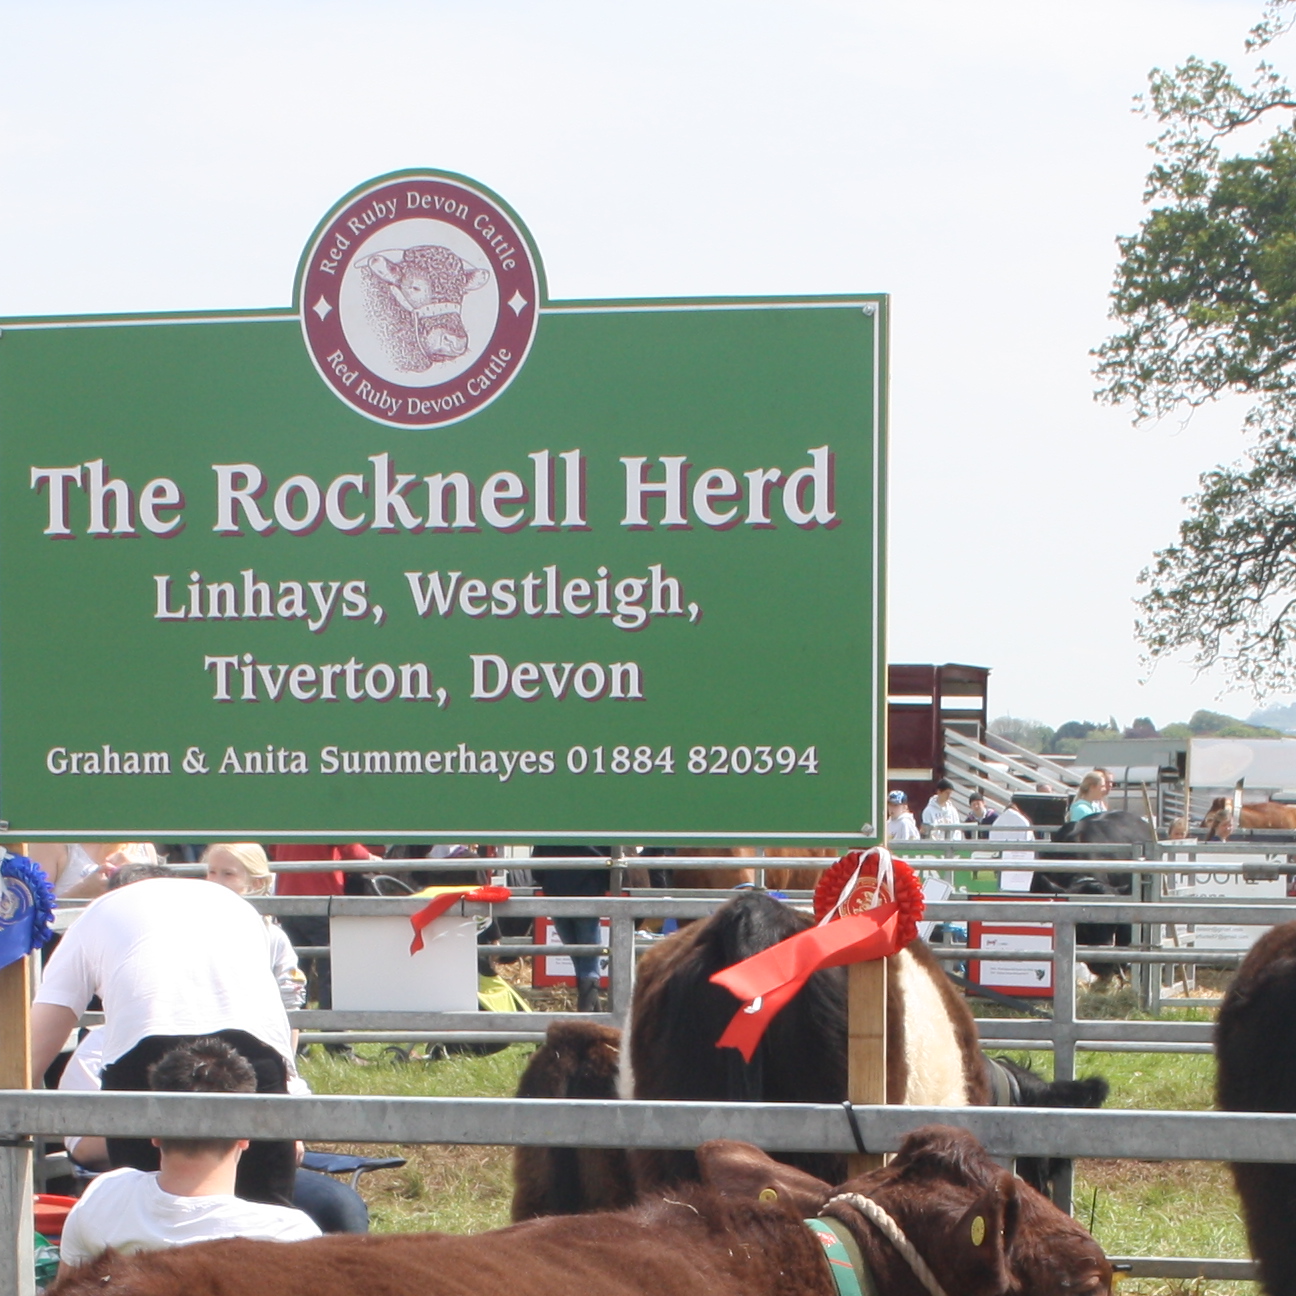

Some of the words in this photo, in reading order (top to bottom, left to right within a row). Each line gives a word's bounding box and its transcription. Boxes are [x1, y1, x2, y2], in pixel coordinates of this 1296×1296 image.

[319, 233, 351, 275] Red
[347, 197, 398, 236] Ruby
[406, 191, 470, 220] Devon
[473, 214, 517, 272] Cattle
[326, 349, 359, 387] Red
[355, 379, 403, 417] Ruby
[407, 391, 466, 416] Devon
[466, 347, 512, 397] Cattle
[30, 458, 183, 536] The
[211, 449, 589, 535] Rocknell
[619, 445, 839, 529] Herd
[153, 568, 385, 632] Linhays,
[403, 563, 701, 630] Westleigh,
[204, 653, 449, 708] Tiverton,
[469, 654, 644, 701] Devon
[46, 744, 172, 775] Graham
[182, 746, 210, 775] &
[218, 744, 309, 775] Anita
[320, 742, 556, 782] Summerhayes
[566, 745, 676, 775] 01884
[687, 745, 820, 775] 820394
